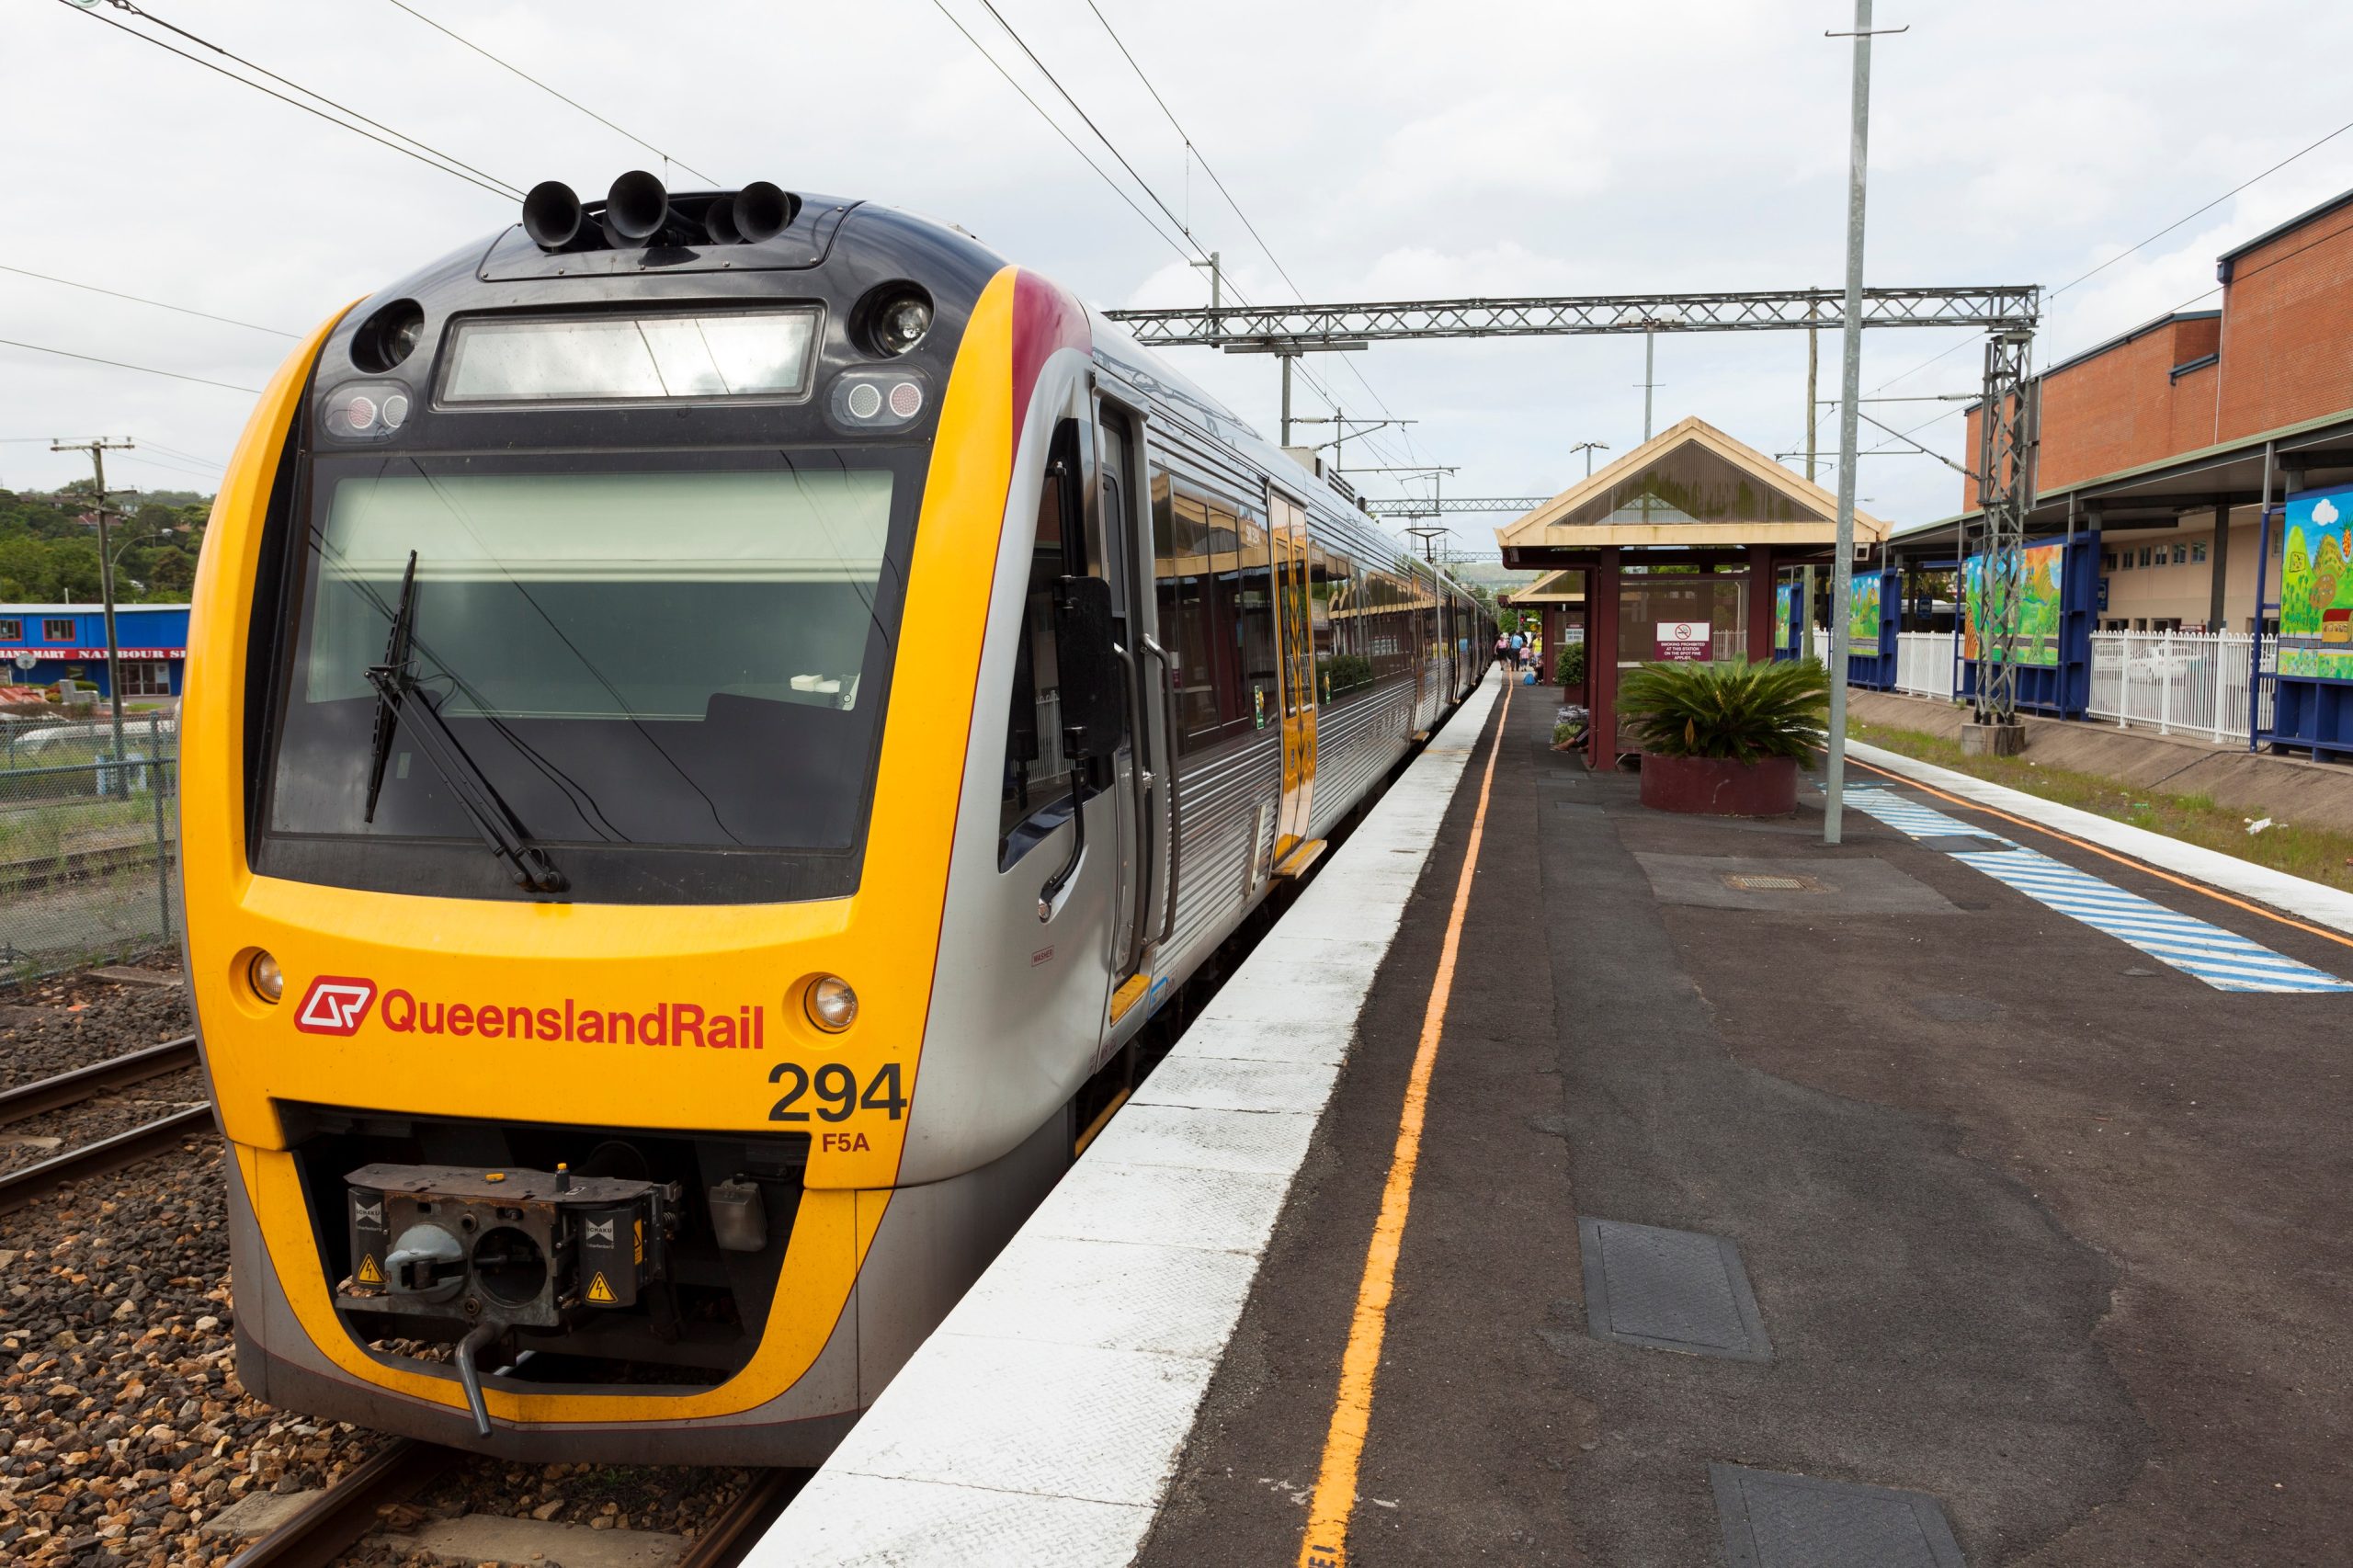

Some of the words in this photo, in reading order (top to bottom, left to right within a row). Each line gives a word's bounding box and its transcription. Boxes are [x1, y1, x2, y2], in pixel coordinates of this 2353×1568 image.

[33, 650, 66, 659] MART
[1033, 949, 1052, 963] WASHER
[768, 1062, 908, 1122] 294
[822, 1132, 870, 1153] F5A
